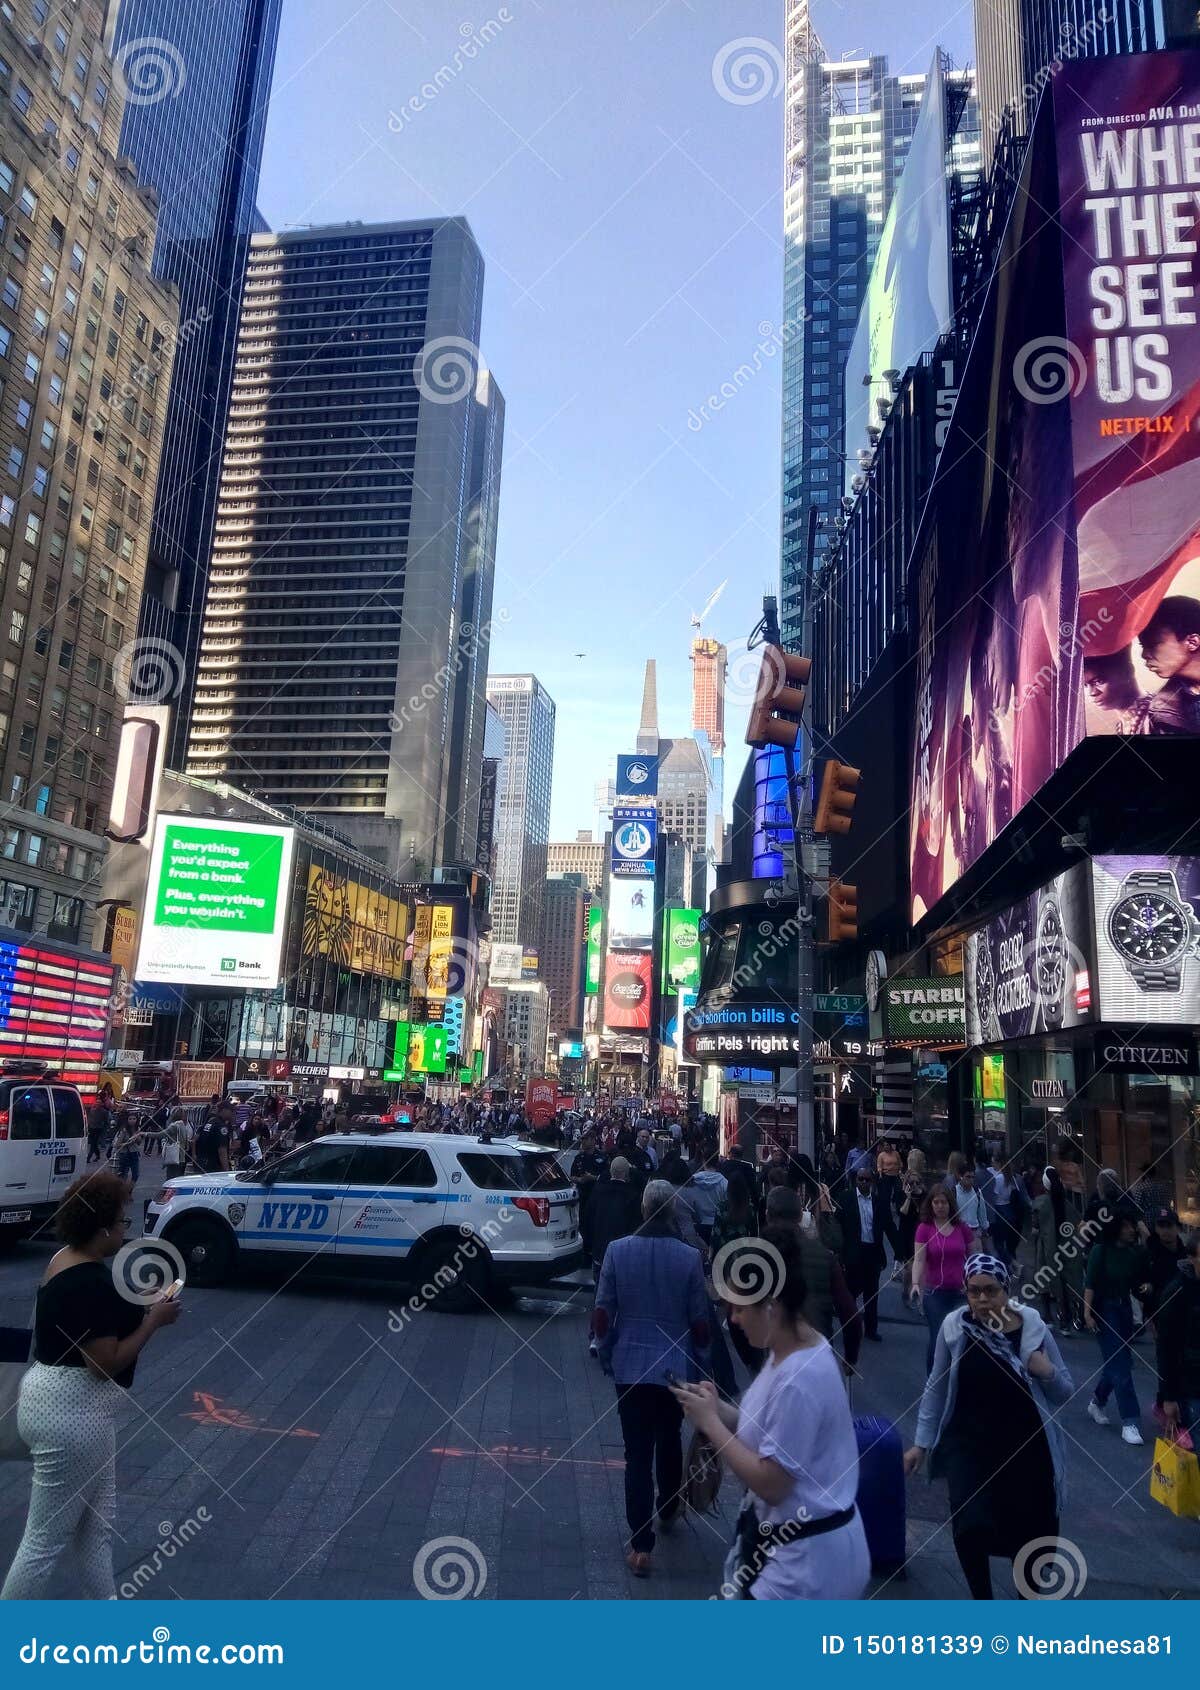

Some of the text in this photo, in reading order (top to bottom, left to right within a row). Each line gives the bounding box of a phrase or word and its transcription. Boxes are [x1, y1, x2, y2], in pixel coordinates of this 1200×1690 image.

[1082, 118, 1104, 127] FROM
[1106, 114, 1146, 124] DIRECTOR
[1149, 106, 1174, 120] AVA
[1085, 191, 1200, 259] THE
[1090, 260, 1197, 331] SEE
[1095, 333, 1173, 404] US
[1100, 416, 1174, 437] NETFLIX
[487, 680, 512, 689] llianz
[480, 775, 494, 833] TIMES
[172, 839, 240, 857] Everything
[170, 855, 250, 870] you'd expect
[168, 868, 246, 884] from a bank.
[165, 888, 266, 909] Plus, everything
[163, 904, 247, 920] you wouldn't.
[434, 920, 449, 929] LION
[433, 929, 450, 938] KING
[222, 960, 262, 970] TD Bank
[612, 983, 645, 995] Coca-Cola
[817, 998, 828, 1010] W
[832, 999, 849, 1011] 43
[705, 1009, 747, 1025] abortion
[751, 1008, 785, 1024] bills
[718, 1036, 743, 1051] Pels
[747, 1036, 789, 1055] 'right
[1104, 1046, 1189, 1065] CITIZEN
[291, 1065, 329, 1076] SKECHERS
[1032, 1079, 1065, 1098] CITIZEN
[34, 1148, 70, 1156] POLICE
[193, 1187, 222, 1196] POLICE
[257, 1202, 329, 1230] NYPD
